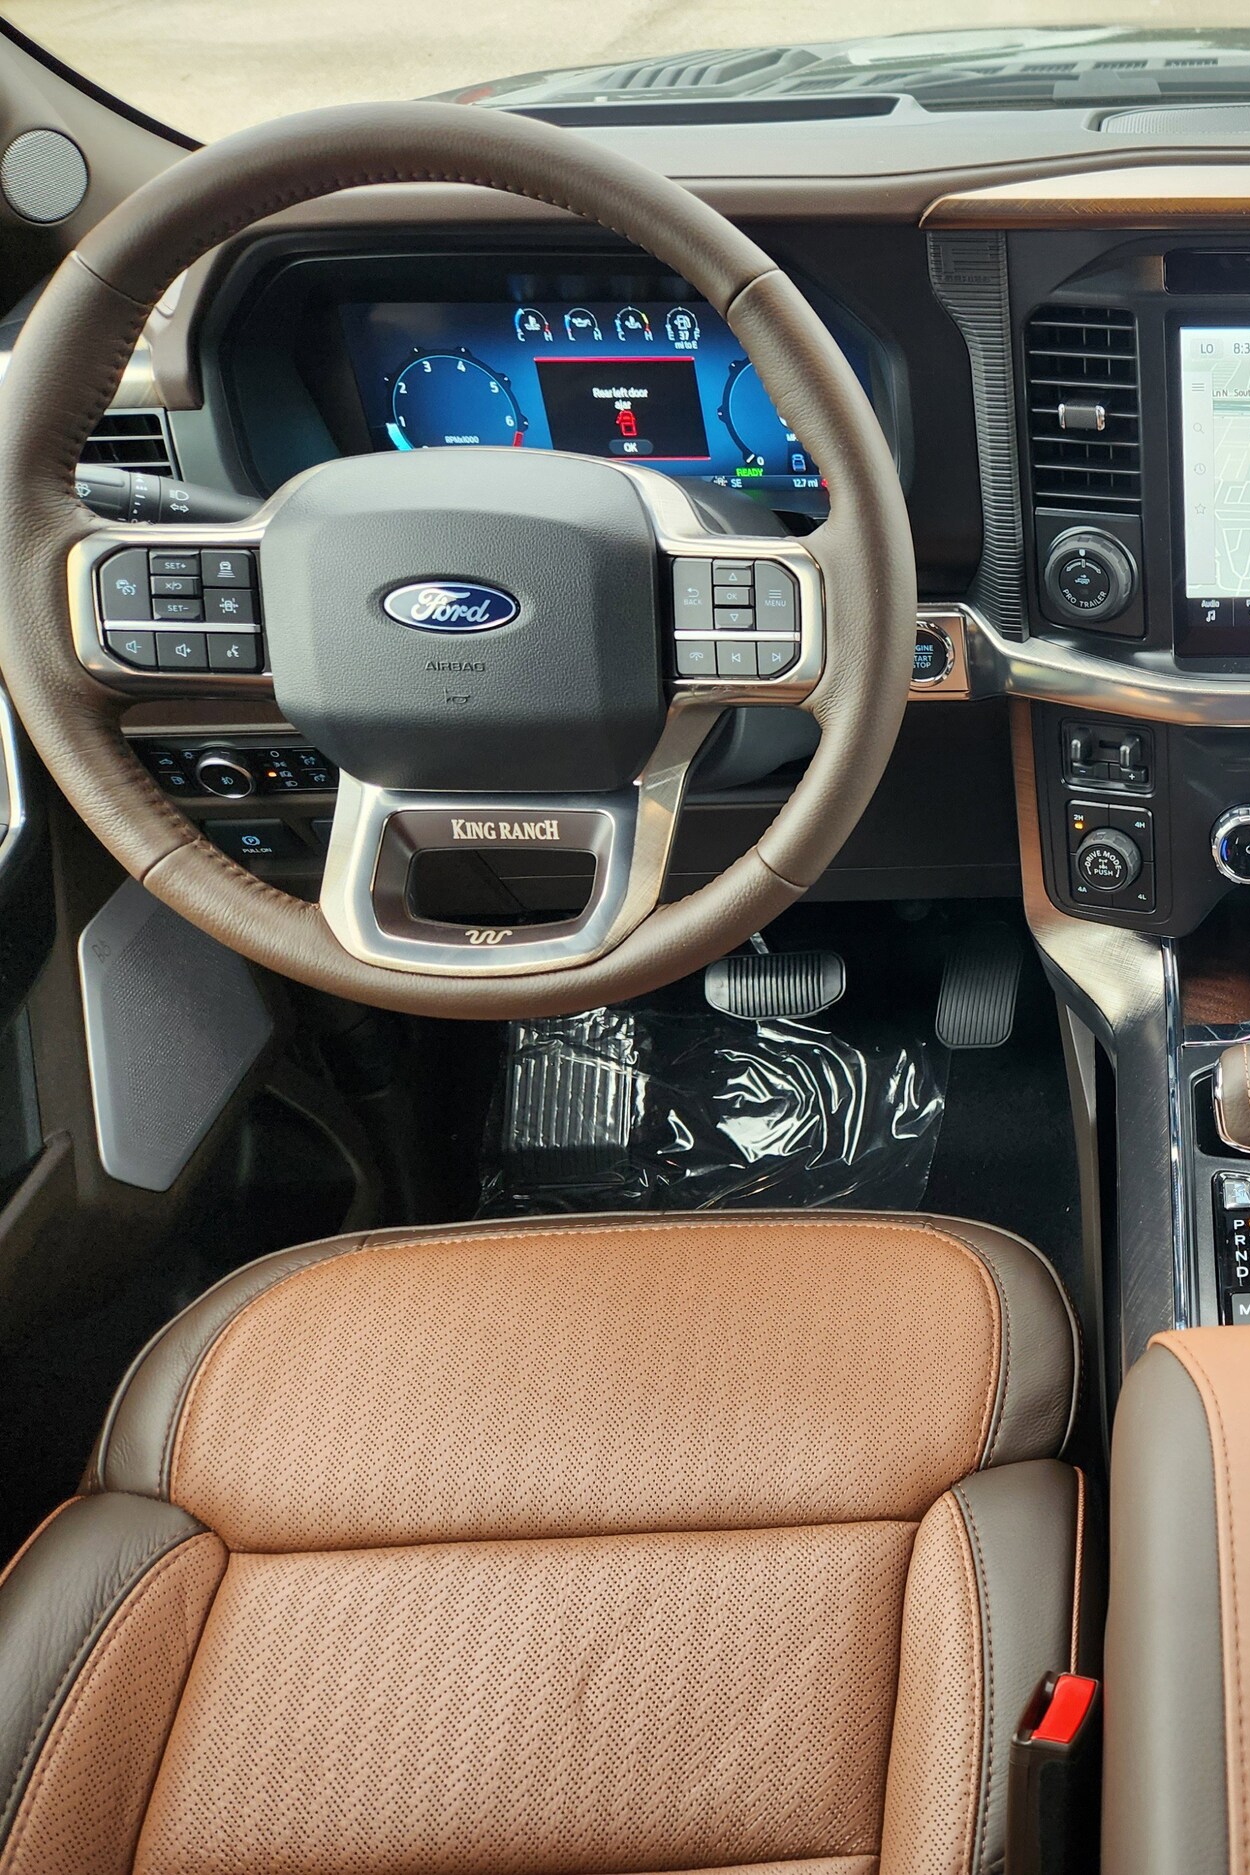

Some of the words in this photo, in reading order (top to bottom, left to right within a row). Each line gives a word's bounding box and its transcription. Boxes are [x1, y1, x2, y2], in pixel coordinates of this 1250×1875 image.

[678, 330, 690, 341] 37
[1200, 343, 1214, 354] LO
[422, 360, 432, 373] 3
[456, 360, 466, 373] 4
[397, 382, 408, 395] 2
[489, 382, 500, 394] 5
[592, 387, 613, 399] Rear
[612, 386, 629, 399] left
[628, 386, 648, 399] door
[614, 399, 632, 411] ajar
[398, 415, 406, 428] 1
[504, 415, 515, 427] 6
[623, 442, 638, 453] OK
[756, 456, 765, 466] 0
[736, 467, 764, 477] READY
[730, 478, 743, 488] SE
[683, 597, 702, 606] BACK
[726, 591, 738, 601] OK
[1062, 588, 1078, 604] PRO
[1079, 590, 1108, 609] TRAILER
[410, 588, 492, 624] Ford
[764, 598, 787, 608] MENU
[1201, 600, 1220, 609] Audio
[913, 644, 935, 652] GINE
[913, 655, 933, 663] TART
[424, 661, 486, 673] AIRBAG
[1073, 813, 1085, 822] 2H
[451, 818, 498, 840] KING
[498, 819, 560, 841] RANCH
[1134, 820, 1146, 829] 4H
[1093, 867, 1114, 877] PUSH
[1077, 885, 1088, 894] 4A
[1137, 892, 1147, 901] 4L
[1233, 1219, 1245, 1230] P
[1234, 1234, 1246, 1246] R
[1235, 1250, 1248, 1262] N
[1236, 1265, 1249, 1278] D
